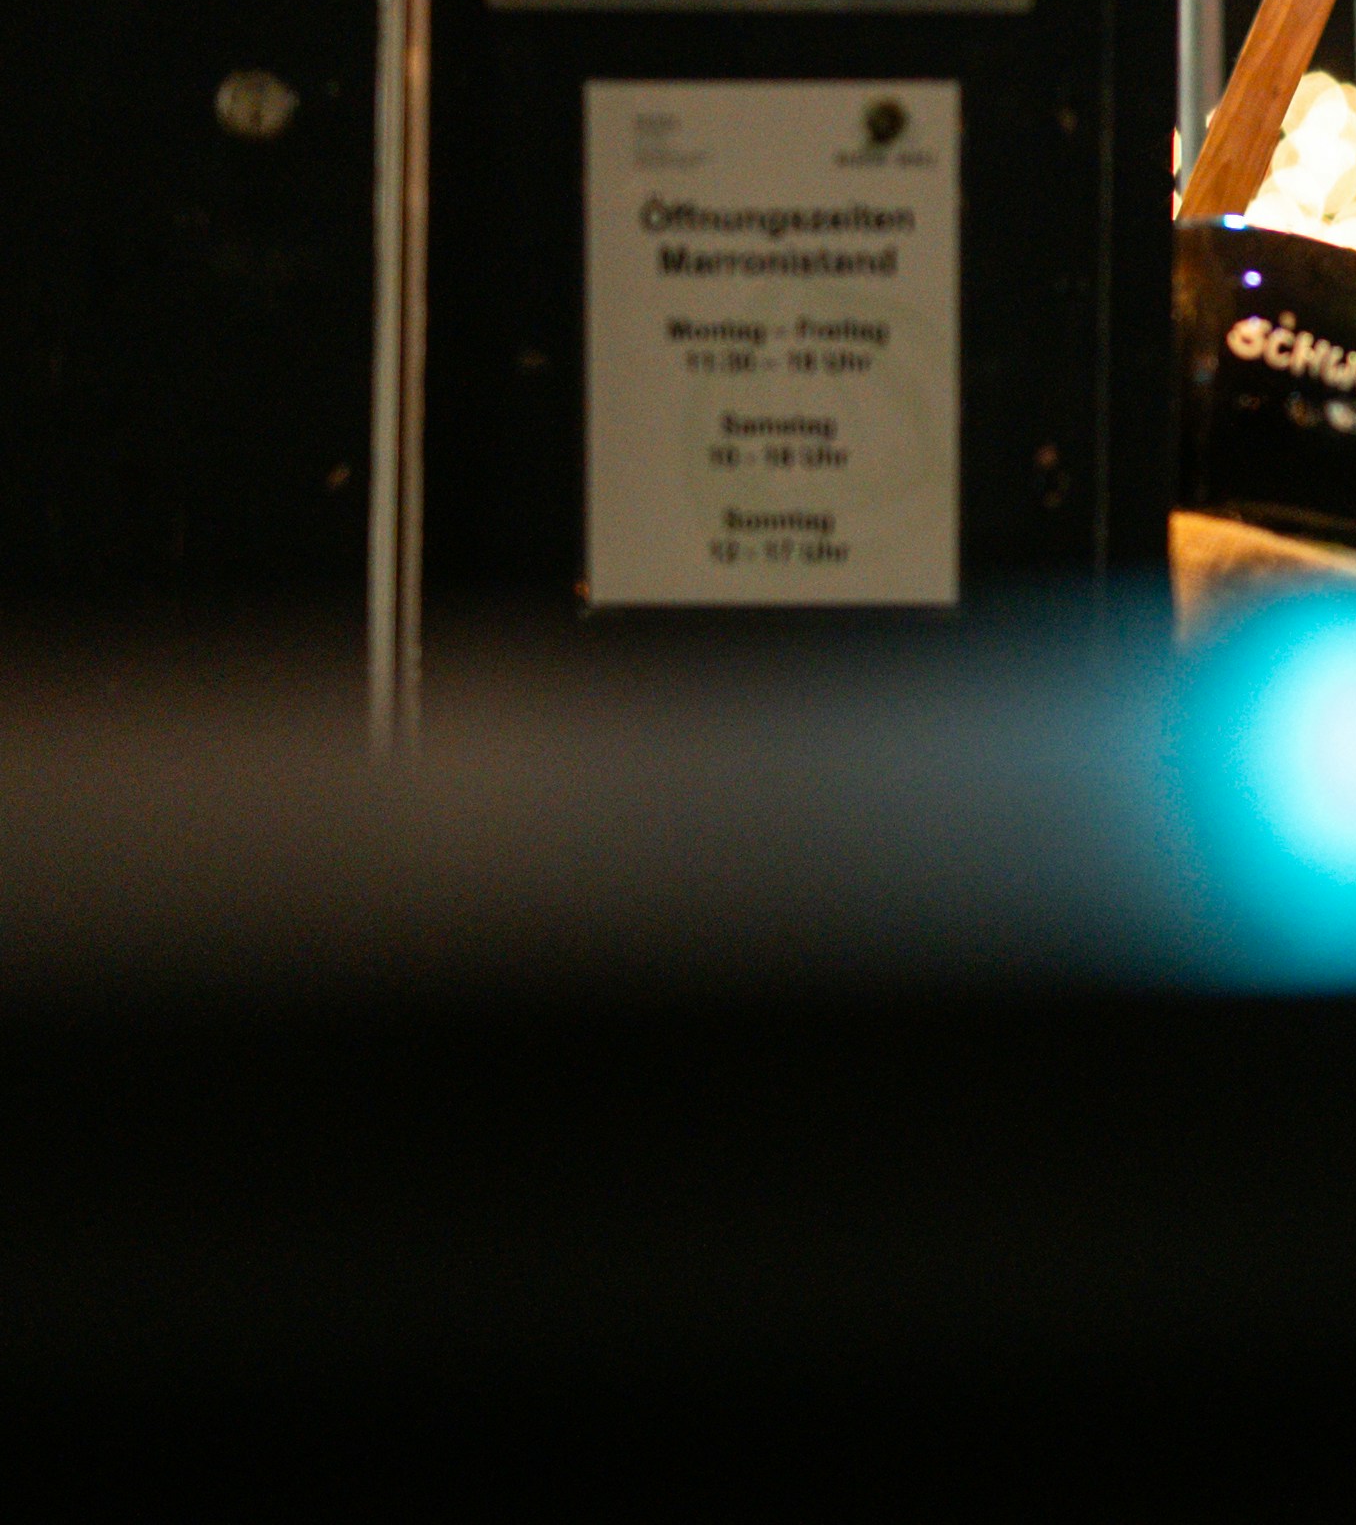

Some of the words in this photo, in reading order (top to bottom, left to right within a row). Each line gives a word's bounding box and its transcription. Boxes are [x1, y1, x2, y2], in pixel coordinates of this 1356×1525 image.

[640, 194, 916, 240] Öffnungszeiten
[659, 245, 898, 277] Marronistand
[667, 318, 766, 347] Montag
[796, 318, 890, 348] Freitag
[722, 413, 837, 442] Samstag
[724, 507, 835, 537] Sonntag
